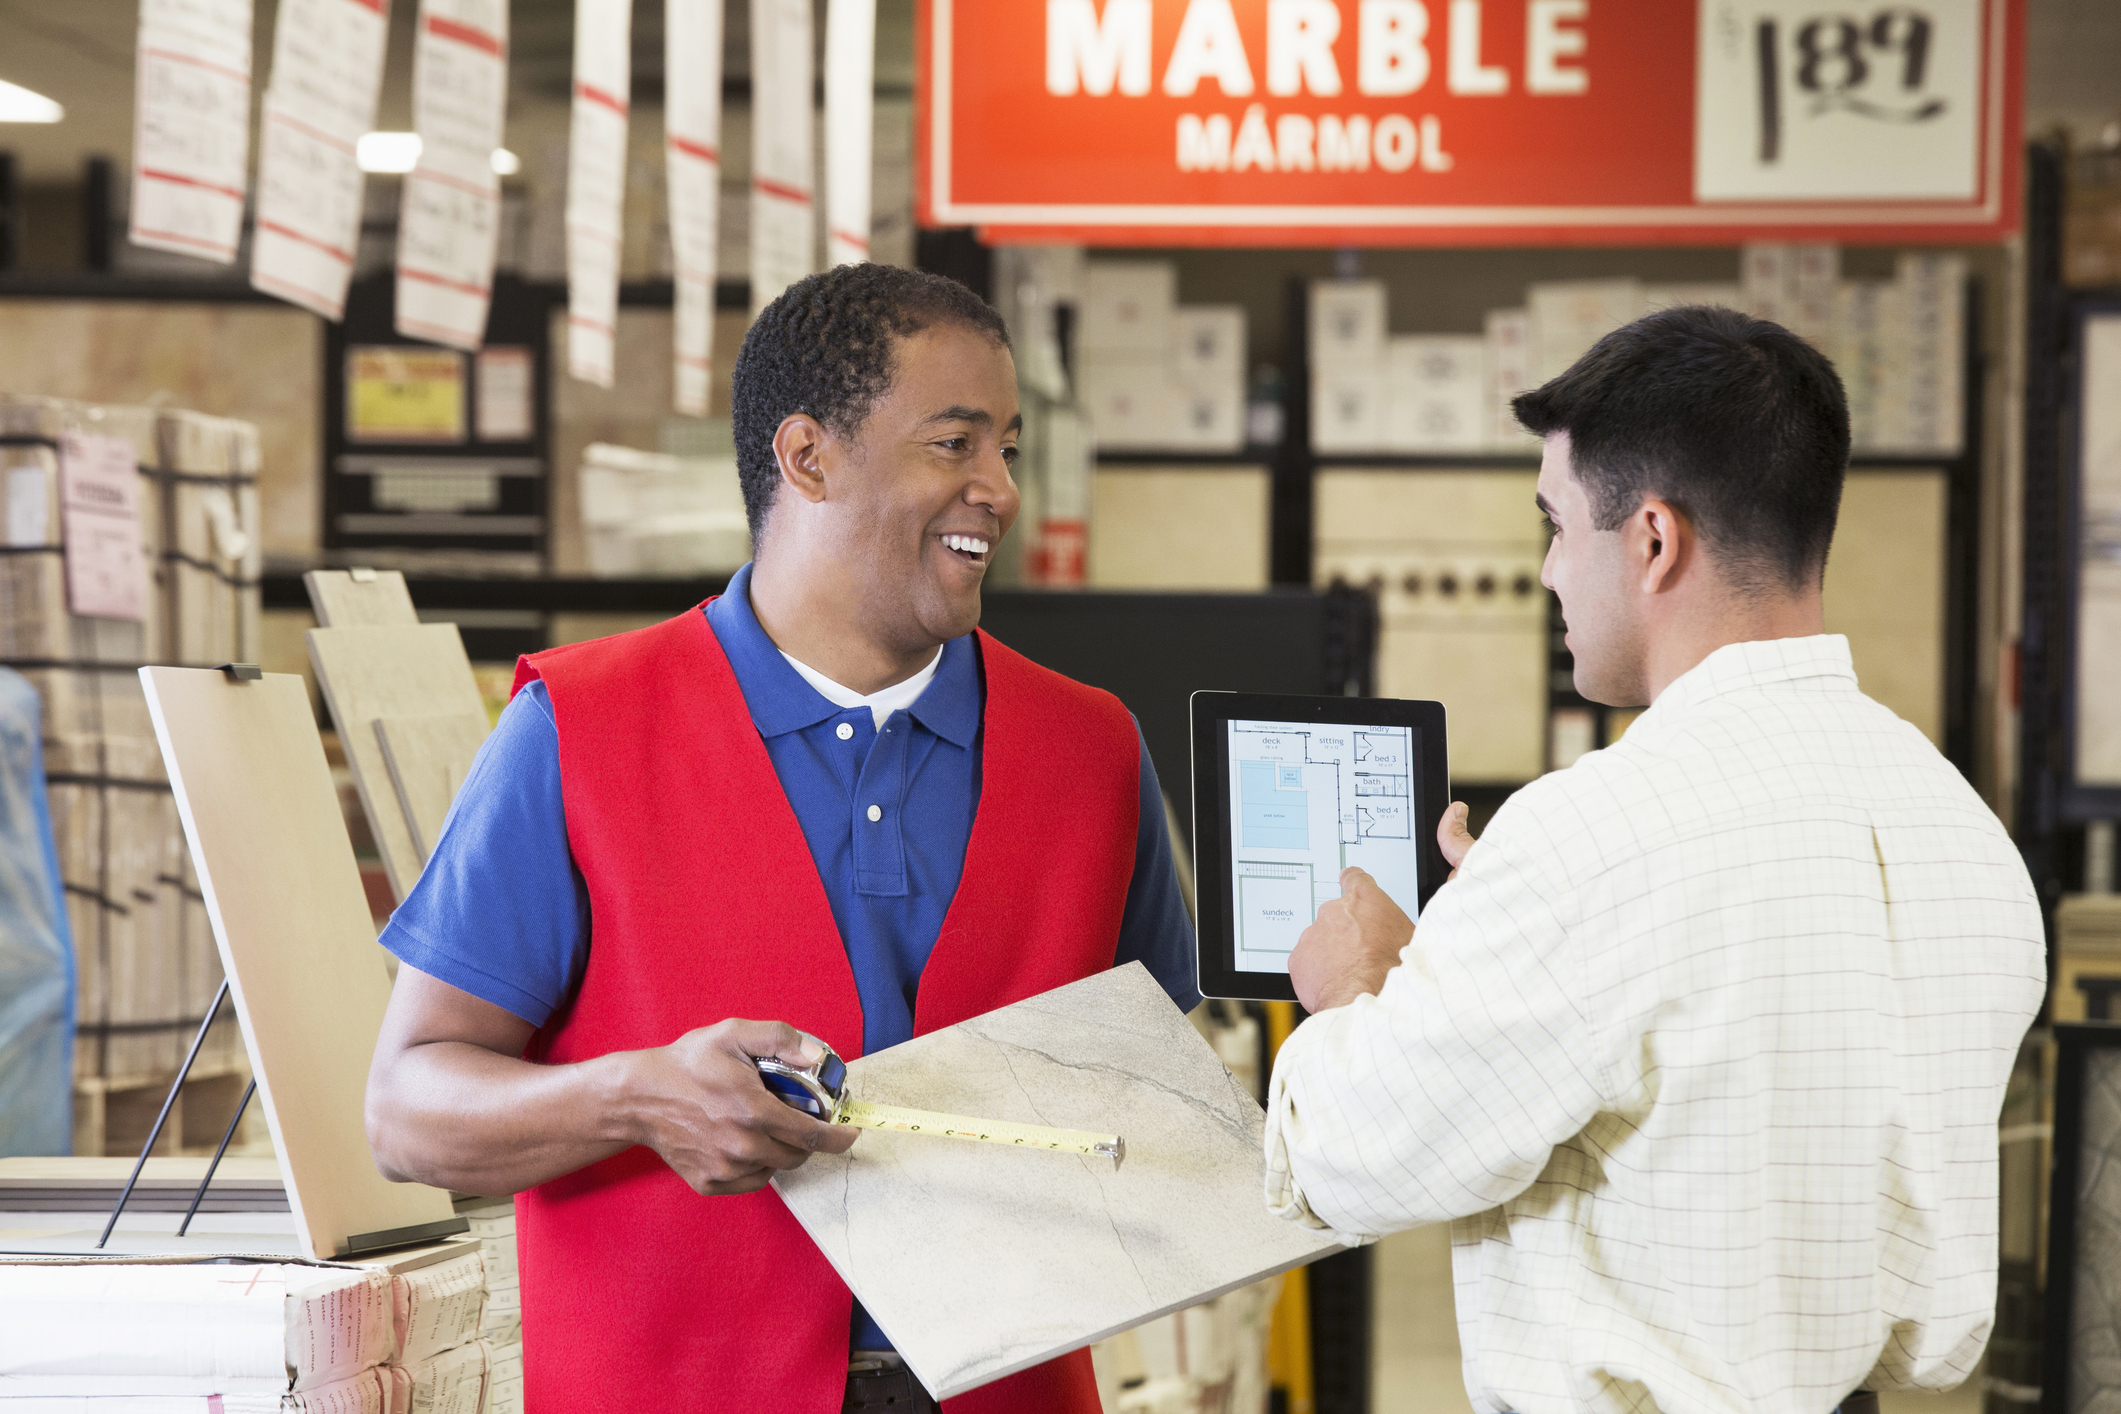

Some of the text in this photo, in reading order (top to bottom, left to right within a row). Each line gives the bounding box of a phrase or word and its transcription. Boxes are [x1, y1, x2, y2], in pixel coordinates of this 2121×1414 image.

[1044, 0, 1591, 98] MARBLE
[1175, 102, 1455, 174] MÁRMOL
[1319, 738, 1344, 746] sitting
[310, 1330, 315, 1340] IN
